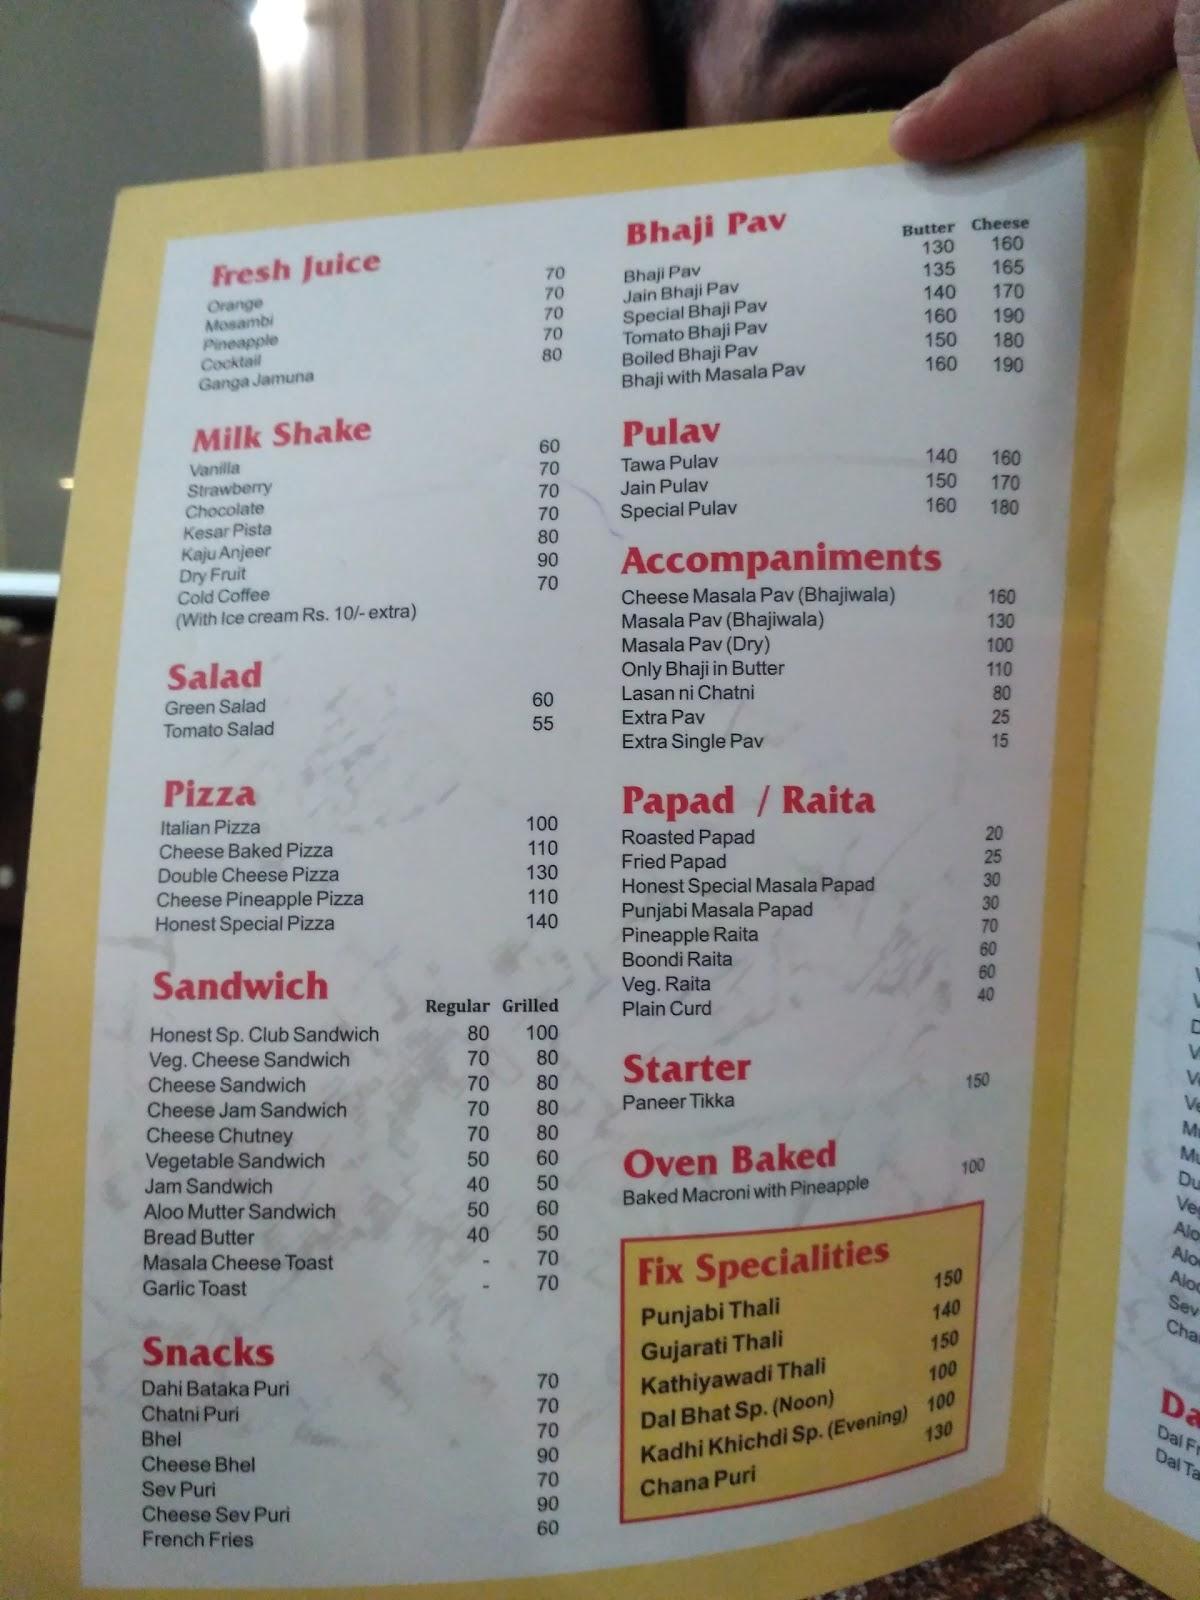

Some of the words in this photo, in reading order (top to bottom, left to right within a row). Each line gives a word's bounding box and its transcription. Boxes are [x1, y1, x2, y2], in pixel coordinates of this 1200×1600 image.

[627, 214, 714, 246] Bhaji
[727, 211, 787, 236] Pav
[901, 223, 956, 238] Butter
[970, 217, 1030, 231] Cheese
[991, 235, 1025, 252] 160
[211, 258, 291, 288] Fresh
[302, 252, 381, 284] Juice
[546, 265, 566, 281] 70
[623, 267, 665, 284] Bhaji
[668, 265, 701, 279] Pav
[923, 260, 956, 278] 135
[206, 298, 264, 314] Orange
[544, 305, 565, 321] 70
[623, 305, 685, 327] Special
[688, 301, 731, 320] Bhaji
[734, 299, 768, 315] Pav
[993, 307, 1025, 325] 190
[202, 333, 280, 352] Pineapple
[925, 331, 958, 348] 150
[622, 348, 675, 368] Boiled
[678, 345, 721, 364] Bhaji
[724, 343, 759, 359] Pav
[993, 355, 1025, 374] 190
[198, 376, 251, 393] Ganga
[251, 371, 315, 388] Jamuna
[192, 424, 262, 453] Milk
[272, 417, 372, 447] Shake
[623, 417, 721, 448] Pulav
[539, 438, 561, 454] 60
[620, 457, 666, 473] Tawa
[669, 454, 719, 471] Pulav
[187, 481, 273, 499] Strawberry
[538, 482, 560, 499] 70
[991, 474, 1021, 492] 170
[620, 501, 684, 523] Special
[688, 500, 738, 517] Pulav
[926, 496, 957, 514] 160
[183, 526, 231, 541] Kesar
[232, 522, 273, 538] Pista
[537, 551, 559, 568] 90
[620, 541, 942, 580] Accompaniments
[179, 568, 208, 586] Dry
[209, 566, 247, 582] Fruit
[175, 611, 218, 631] (With
[221, 611, 245, 626] Ice
[247, 610, 299, 625] cream
[302, 607, 329, 623] Rs.
[335, 605, 366, 621] 10/-
[368, 602, 417, 622] extra)
[621, 612, 685, 629] Masala
[688, 612, 723, 628] Pav
[726, 610, 824, 632] (Bhajiwala)
[987, 612, 1016, 630] 130
[167, 660, 263, 691] Salad
[621, 661, 663, 681] Only
[665, 660, 709, 681] Bhaji
[713, 660, 728, 676] in
[732, 659, 786, 676] Butter
[986, 660, 1013, 678] 110
[532, 691, 554, 708] 60
[622, 709, 668, 726] Extra
[671, 708, 706, 725] Pav
[163, 723, 224, 739] Tomato
[226, 720, 275, 737] Salad
[992, 732, 1009, 749] 15
[163, 779, 257, 808] Pizza
[622, 784, 735, 823] Papad
[757, 784, 771, 818] /
[782, 784, 876, 815] Raita
[528, 839, 559, 856] 110
[621, 828, 695, 846] Roasted
[699, 828, 755, 849] Papad
[159, 843, 225, 860] Cheese
[228, 842, 283, 859] Baked
[286, 842, 334, 858] Pizza
[984, 848, 1002, 865] 25
[528, 888, 559, 905] 110
[622, 877, 685, 894] Honest
[687, 877, 752, 898] Special
[755, 877, 818, 894] Masala
[821, 876, 875, 896] Papad
[156, 891, 223, 908] Cheese
[226, 890, 313, 911] Pineapple
[316, 890, 364, 907] Pizza
[981, 917, 999, 934] 70
[622, 926, 711, 947] Pineapple
[713, 926, 759, 942] Raita
[978, 962, 996, 980] 60
[153, 970, 329, 1001] Sandwich
[621, 976, 661, 997] Veg.
[665, 975, 711, 992] Raita
[425, 998, 491, 1017] Regular
[502, 997, 559, 1013] Grilled
[150, 1026, 213, 1044] Honest
[215, 1026, 244, 1047] Sp.
[248, 1025, 290, 1044] Club
[293, 1025, 380, 1043] Sandwich
[467, 1049, 490, 1067] 70
[623, 1053, 752, 1084] Starter
[148, 1076, 216, 1094] Cheese
[219, 1076, 306, 1094] Sandwich
[536, 1074, 559, 1091] 80
[467, 1100, 490, 1117] 70
[622, 1094, 687, 1111] Paneer
[688, 1092, 735, 1109] Tikka
[146, 1126, 215, 1144] Cheese
[218, 1126, 294, 1148] Chutney
[536, 1124, 559, 1142] 80
[623, 1148, 718, 1179] Oven
[732, 1139, 837, 1174] Baked
[961, 1157, 986, 1176] 100
[144, 1177, 183, 1195] Jam
[185, 1177, 273, 1195] Sandwich
[466, 1175, 490, 1193] 40
[536, 1199, 559, 1217] 60
[143, 1228, 197, 1246] Bread
[200, 1228, 255, 1246] Butter
[466, 1225, 490, 1244] 40
[537, 1249, 559, 1267] 70
[638, 1255, 684, 1287] Fix
[696, 1239, 890, 1289] Specialities
[142, 1279, 196, 1297] Garlic
[198, 1279, 248, 1297] Toast
[641, 1302, 725, 1329] Punjabi
[728, 1296, 780, 1320] Thali
[932, 1298, 961, 1321] 140
[1168, 1294, 1199, 1317] Sev
[143, 1335, 275, 1368] Snacks
[641, 1364, 773, 1396] Kathiyawadi
[776, 1356, 826, 1381] Thali
[537, 1396, 560, 1415] 70
[927, 1390, 956, 1413] 100
[141, 1404, 200, 1423] Chatni
[203, 1405, 240, 1423] Puri
[640, 1439, 704, 1464] Kadhi
[708, 1427, 788, 1457] Khichdi
[791, 1424, 823, 1446] Sp.
[827, 1404, 908, 1441] (Evening)
[1158, 1424, 1184, 1448] Dal
[141, 1455, 212, 1473] Cheese
[215, 1455, 256, 1473] Bhel
[536, 1446, 560, 1464] 90
[1156, 1447, 1181, 1472] Dal
[142, 1505, 212, 1523] Cheese
[215, 1505, 251, 1524] Sev
[254, 1506, 290, 1524] Puri
[536, 1519, 560, 1537] 60
